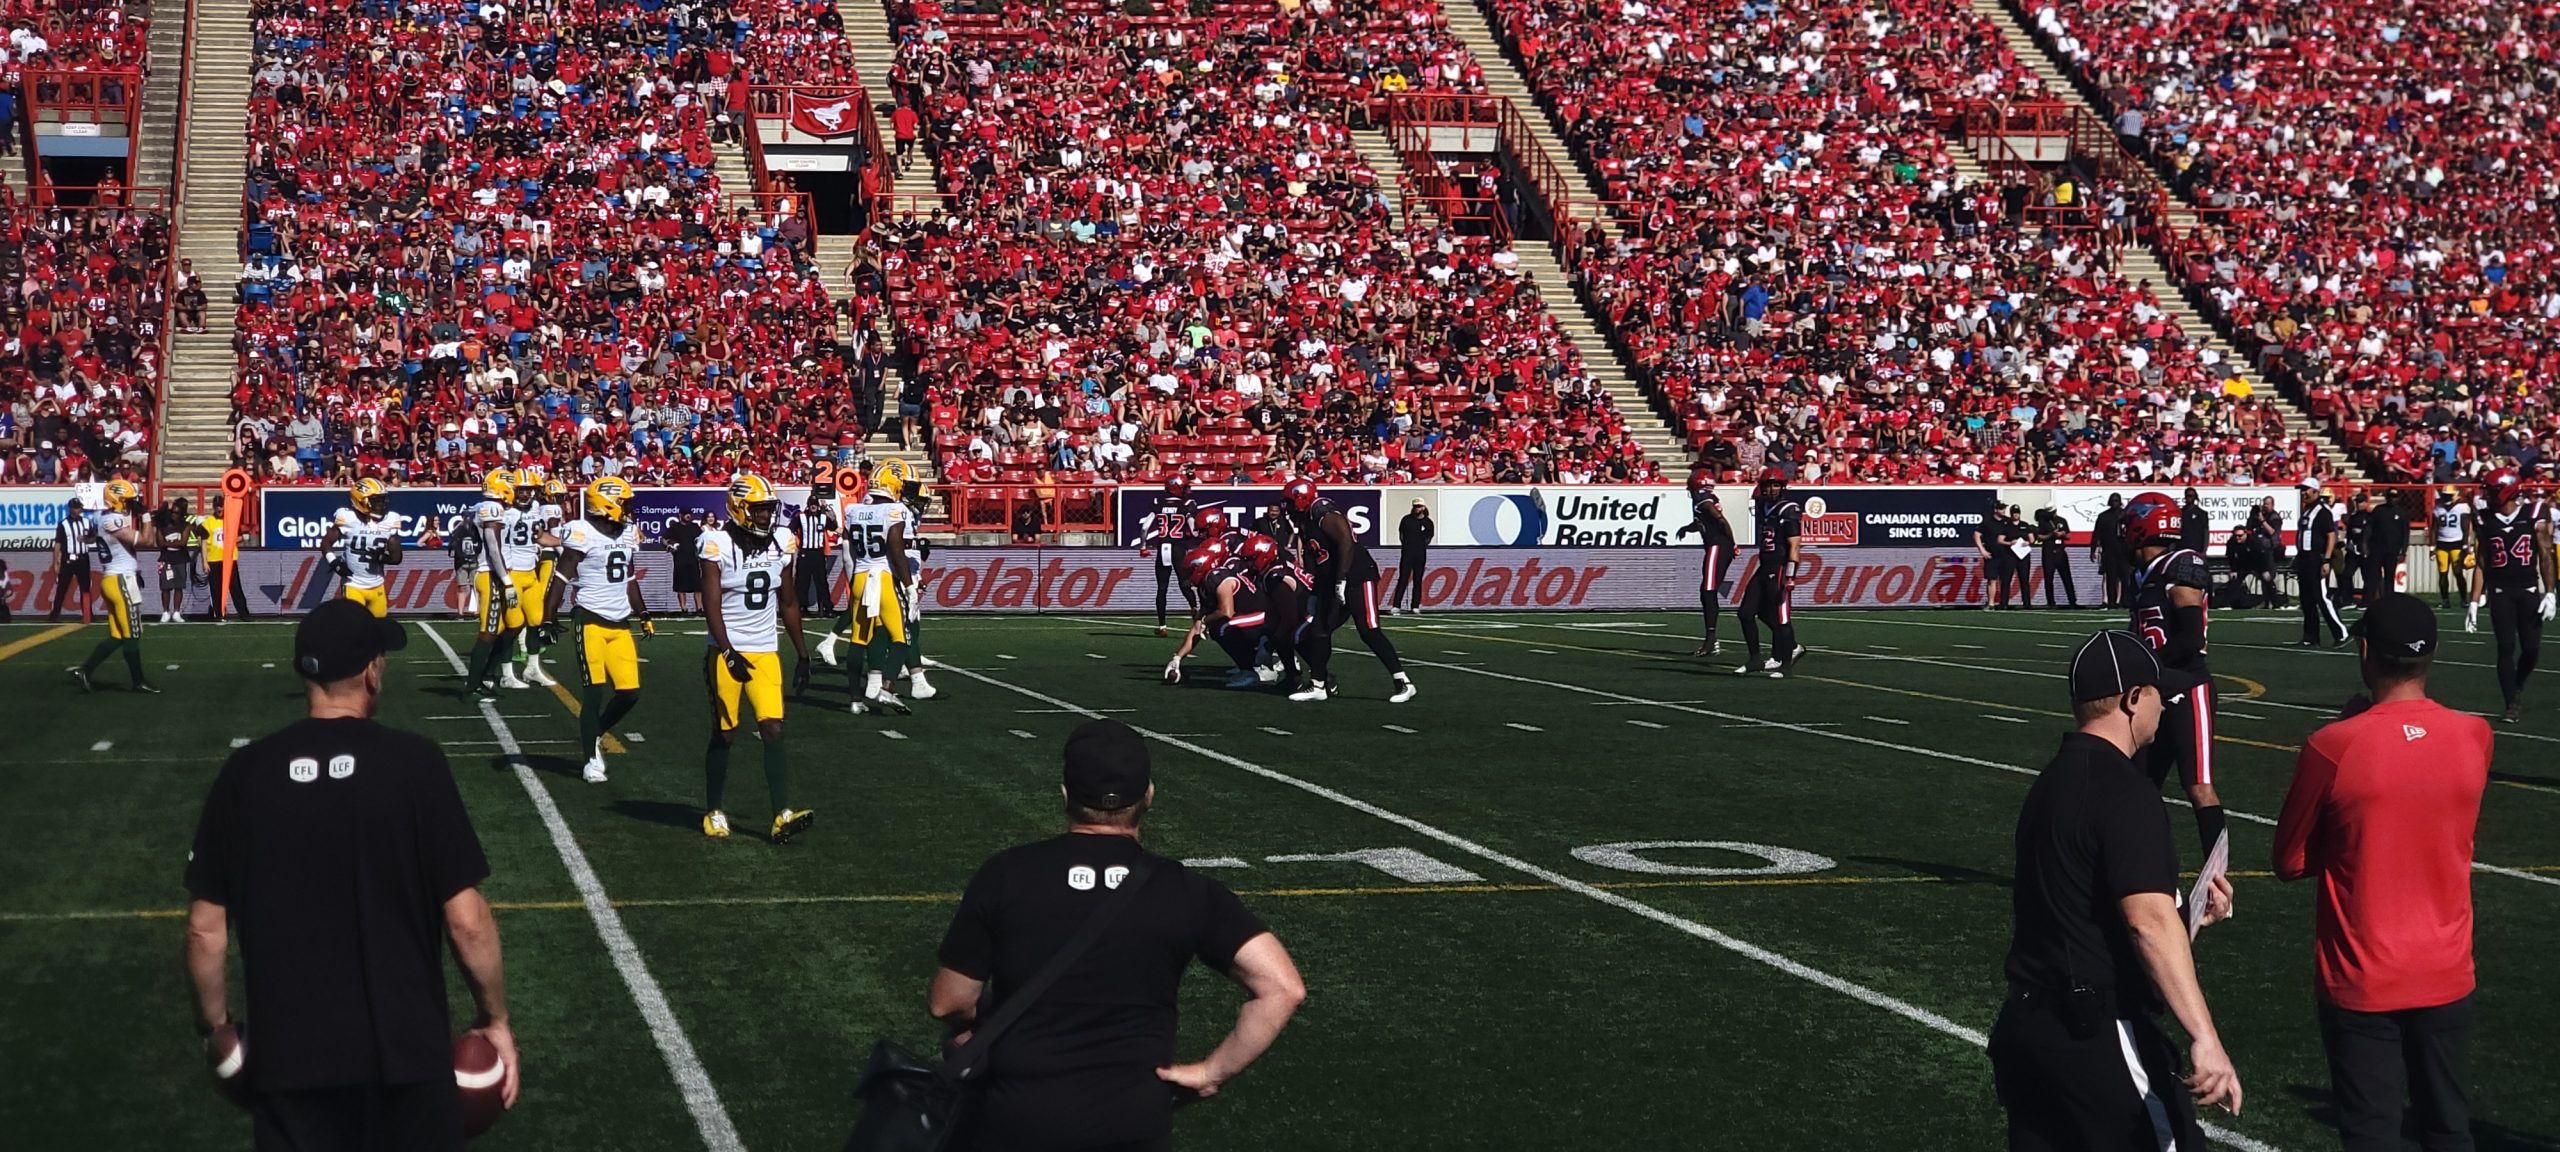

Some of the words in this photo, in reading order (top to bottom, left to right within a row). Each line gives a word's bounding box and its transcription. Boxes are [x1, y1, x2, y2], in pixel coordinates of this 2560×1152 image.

[694, 397, 709, 410] 19
[1262, 412, 1270, 423] 8
[815, 461, 833, 484] 2
[436, 503, 457, 515] We
[641, 506, 680, 516] Stamped
[1556, 496, 1660, 521] United
[1865, 514, 1930, 525] CANADIAN
[1932, 514, 1984, 525] CRAFTED
[2218, 510, 2229, 520] IN
[1555, 524, 1669, 546] Rentals
[1888, 527, 1923, 538] SINCE
[1926, 527, 1960, 538] 1890.
[606, 551, 627, 584] 6
[742, 561, 773, 570] ELKS
[744, 571, 772, 610] 8
[294, 765, 313, 776] CFL
[332, 761, 351, 774] LCF
[1073, 873, 1091, 884] CFL
